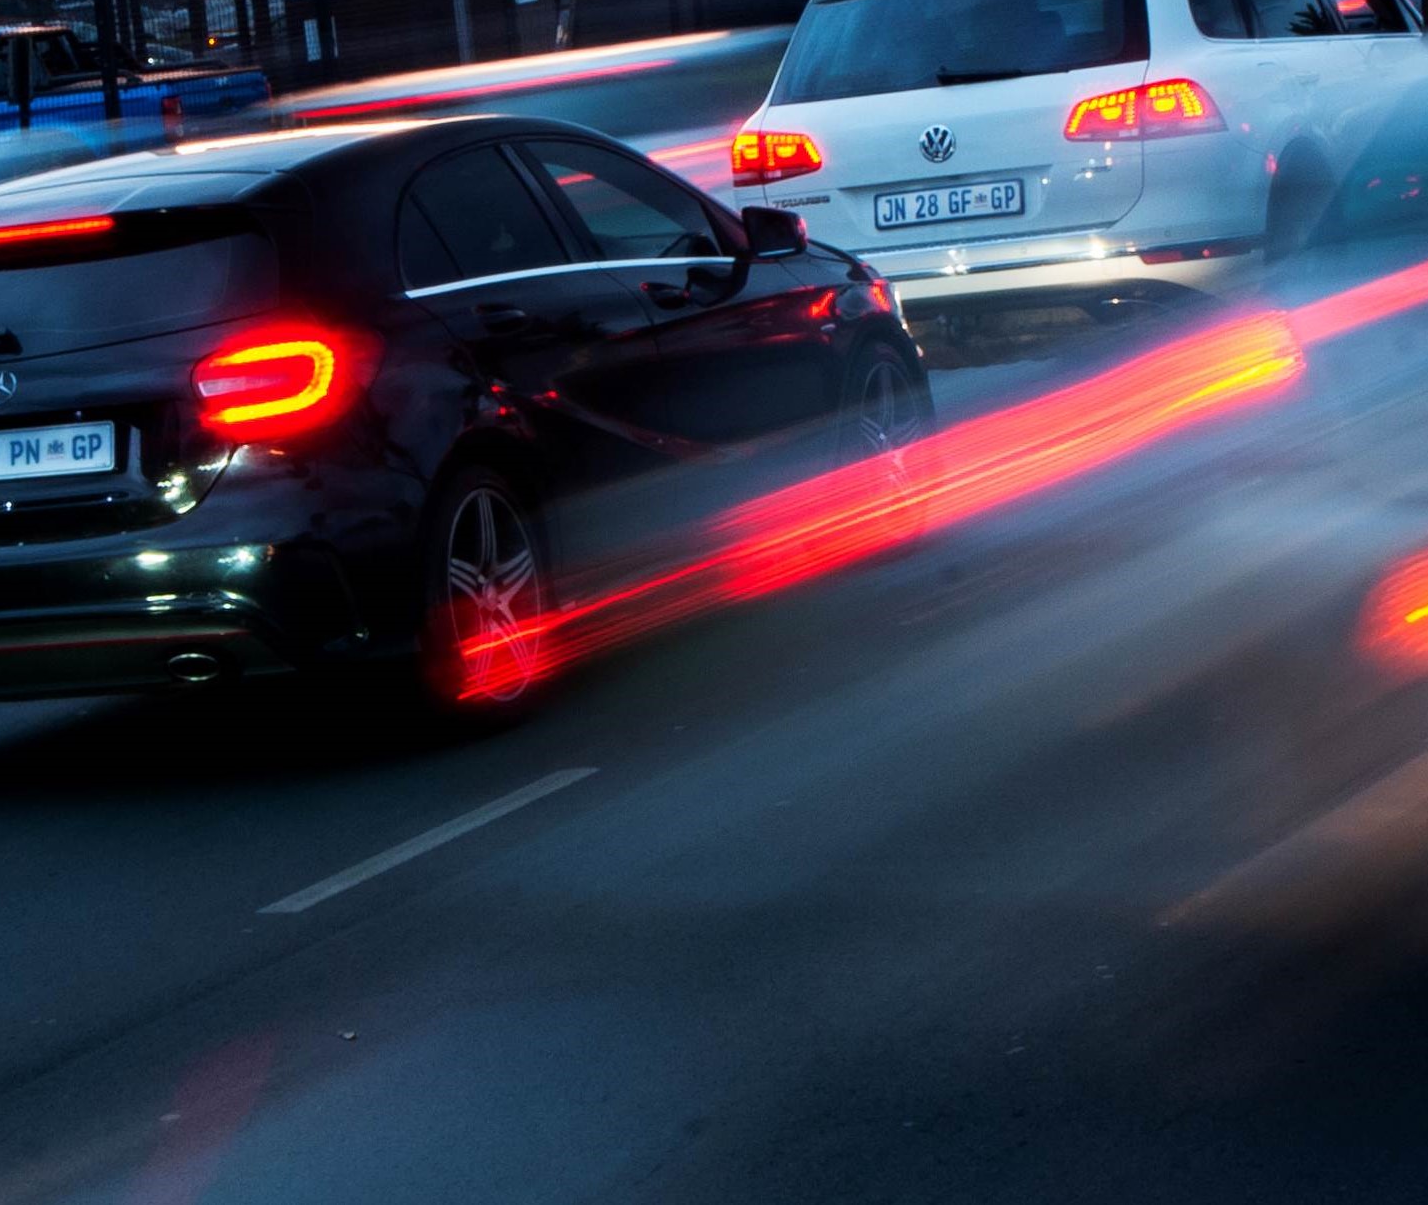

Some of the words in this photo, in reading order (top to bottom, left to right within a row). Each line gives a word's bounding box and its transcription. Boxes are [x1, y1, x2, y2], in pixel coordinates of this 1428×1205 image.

[882, 196, 906, 223] JN
[915, 192, 939, 218] 28
[948, 189, 973, 215] GF
[991, 185, 1016, 210] GP
[9, 438, 41, 467] PN
[72, 433, 102, 461] GP
